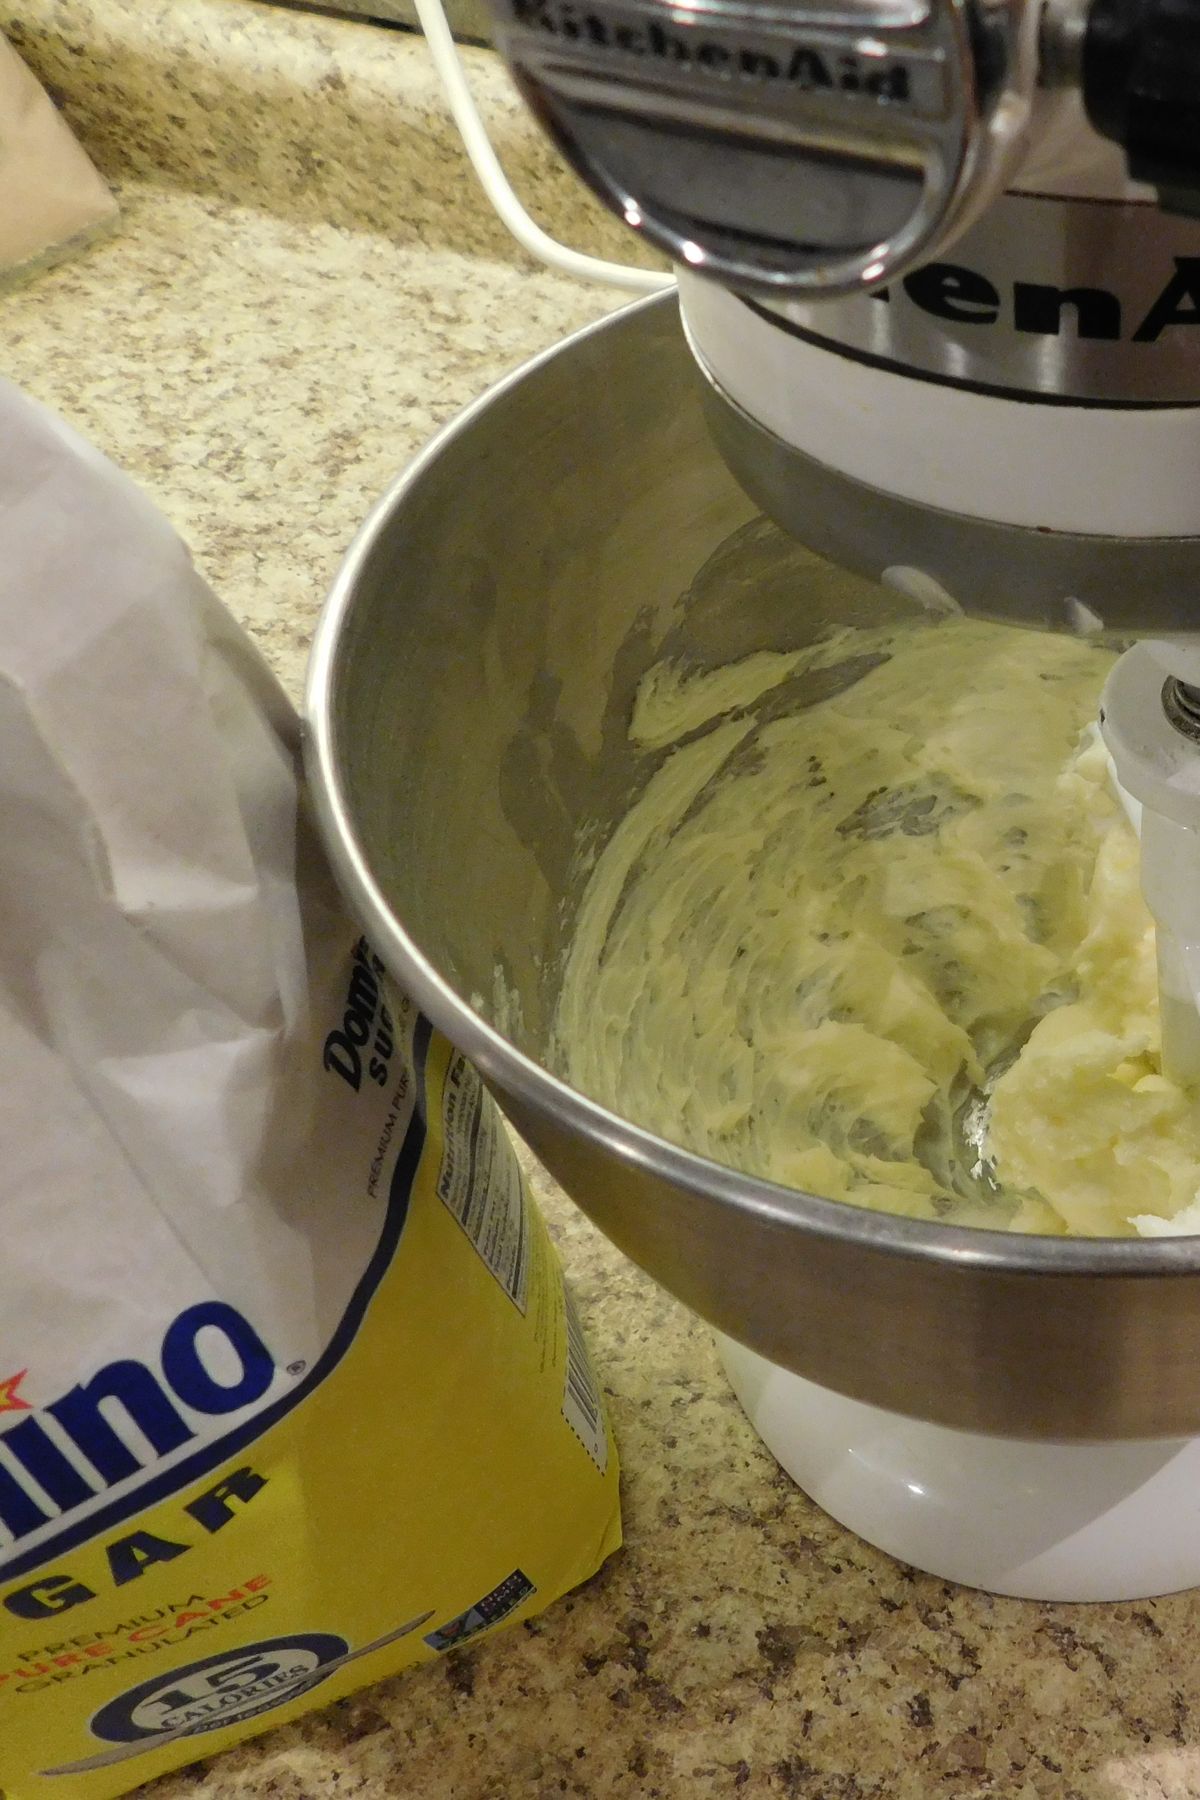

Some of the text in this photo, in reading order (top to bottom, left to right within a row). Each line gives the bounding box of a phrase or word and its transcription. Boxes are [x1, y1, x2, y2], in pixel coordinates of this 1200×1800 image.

[391, 1067, 410, 1108] PUR
[141, 1655, 280, 1715] 15
[160, 1664, 310, 1729] CALORIES
